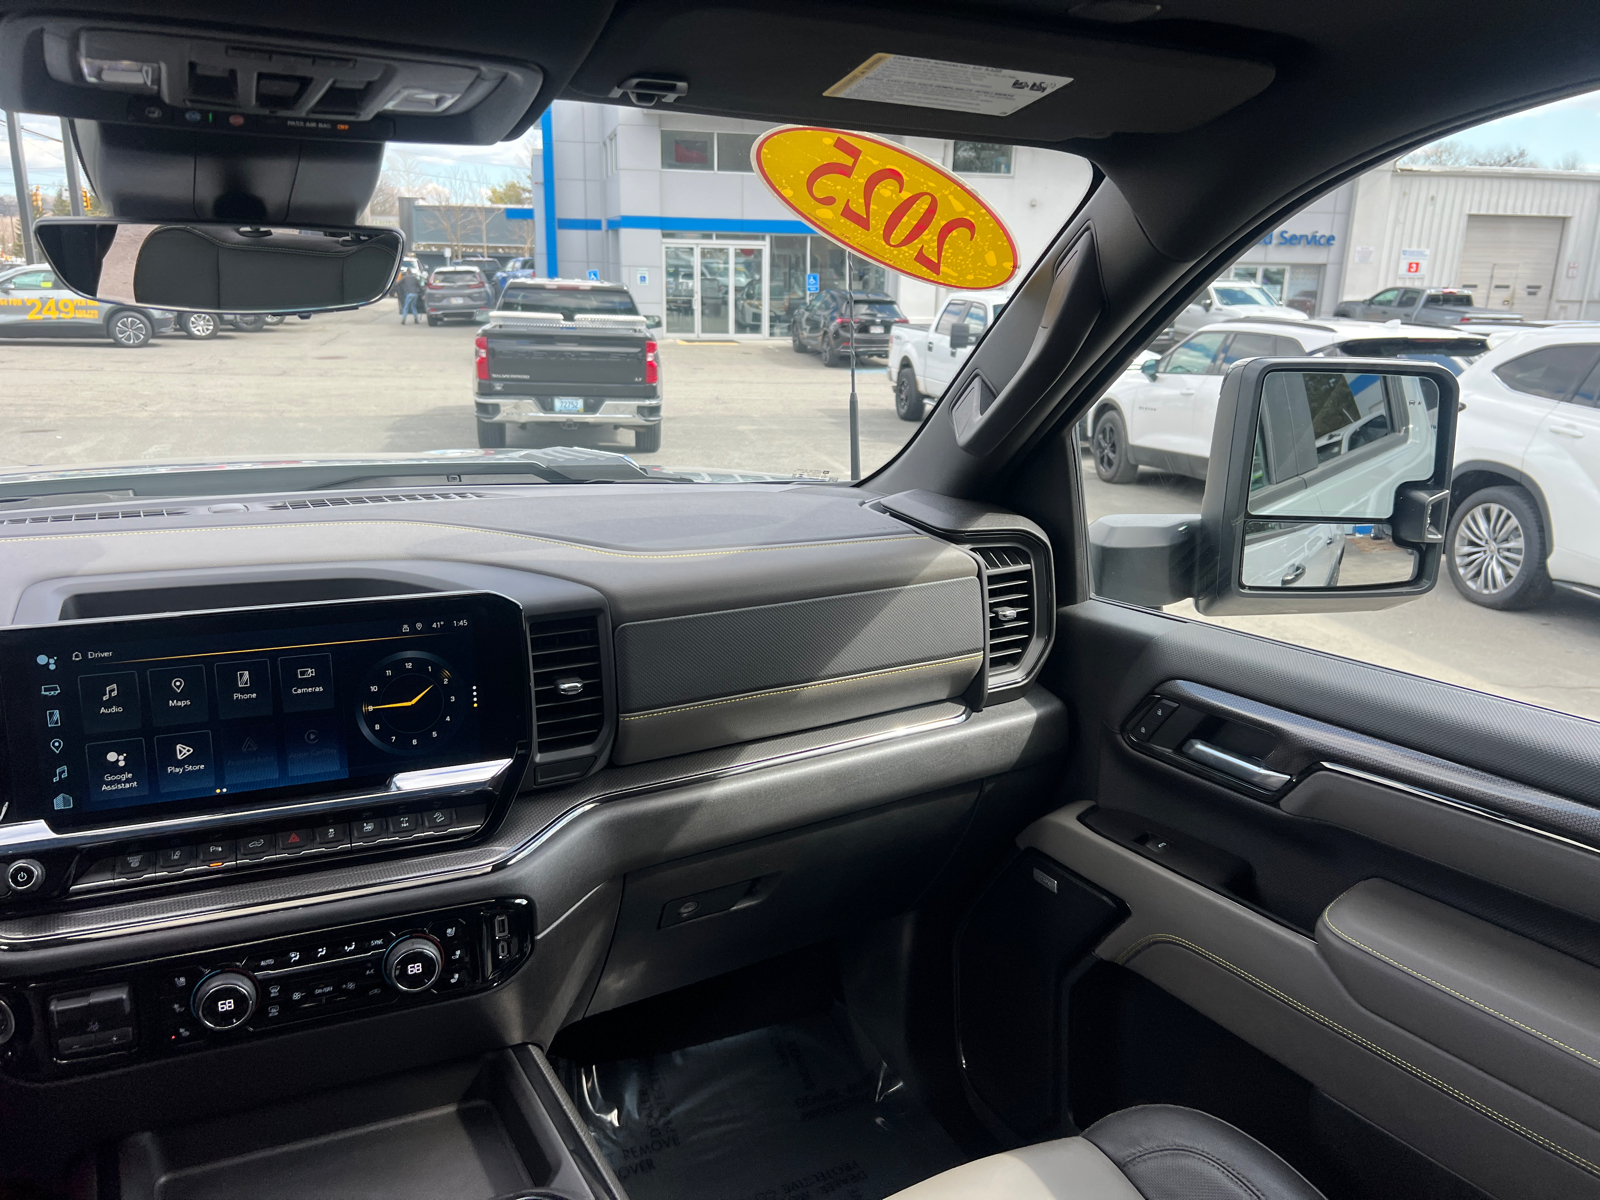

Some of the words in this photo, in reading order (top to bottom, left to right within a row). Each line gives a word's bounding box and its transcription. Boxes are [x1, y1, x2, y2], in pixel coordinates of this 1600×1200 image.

[1278, 230, 1336, 246] Service
[453, 619, 468, 627] 1:45
[88, 651, 113, 659] Driver
[292, 685, 324, 694] Cameras
[233, 692, 257, 700] Phone
[169, 699, 191, 708] Maps
[100, 705, 123, 714] Audio
[167, 765, 184, 774] Play
[184, 763, 205, 772] Store
[104, 771, 133, 782] Google
[101, 781, 138, 792] Assistant
[407, 963, 423, 975] 68
[218, 999, 235, 1012] 68
